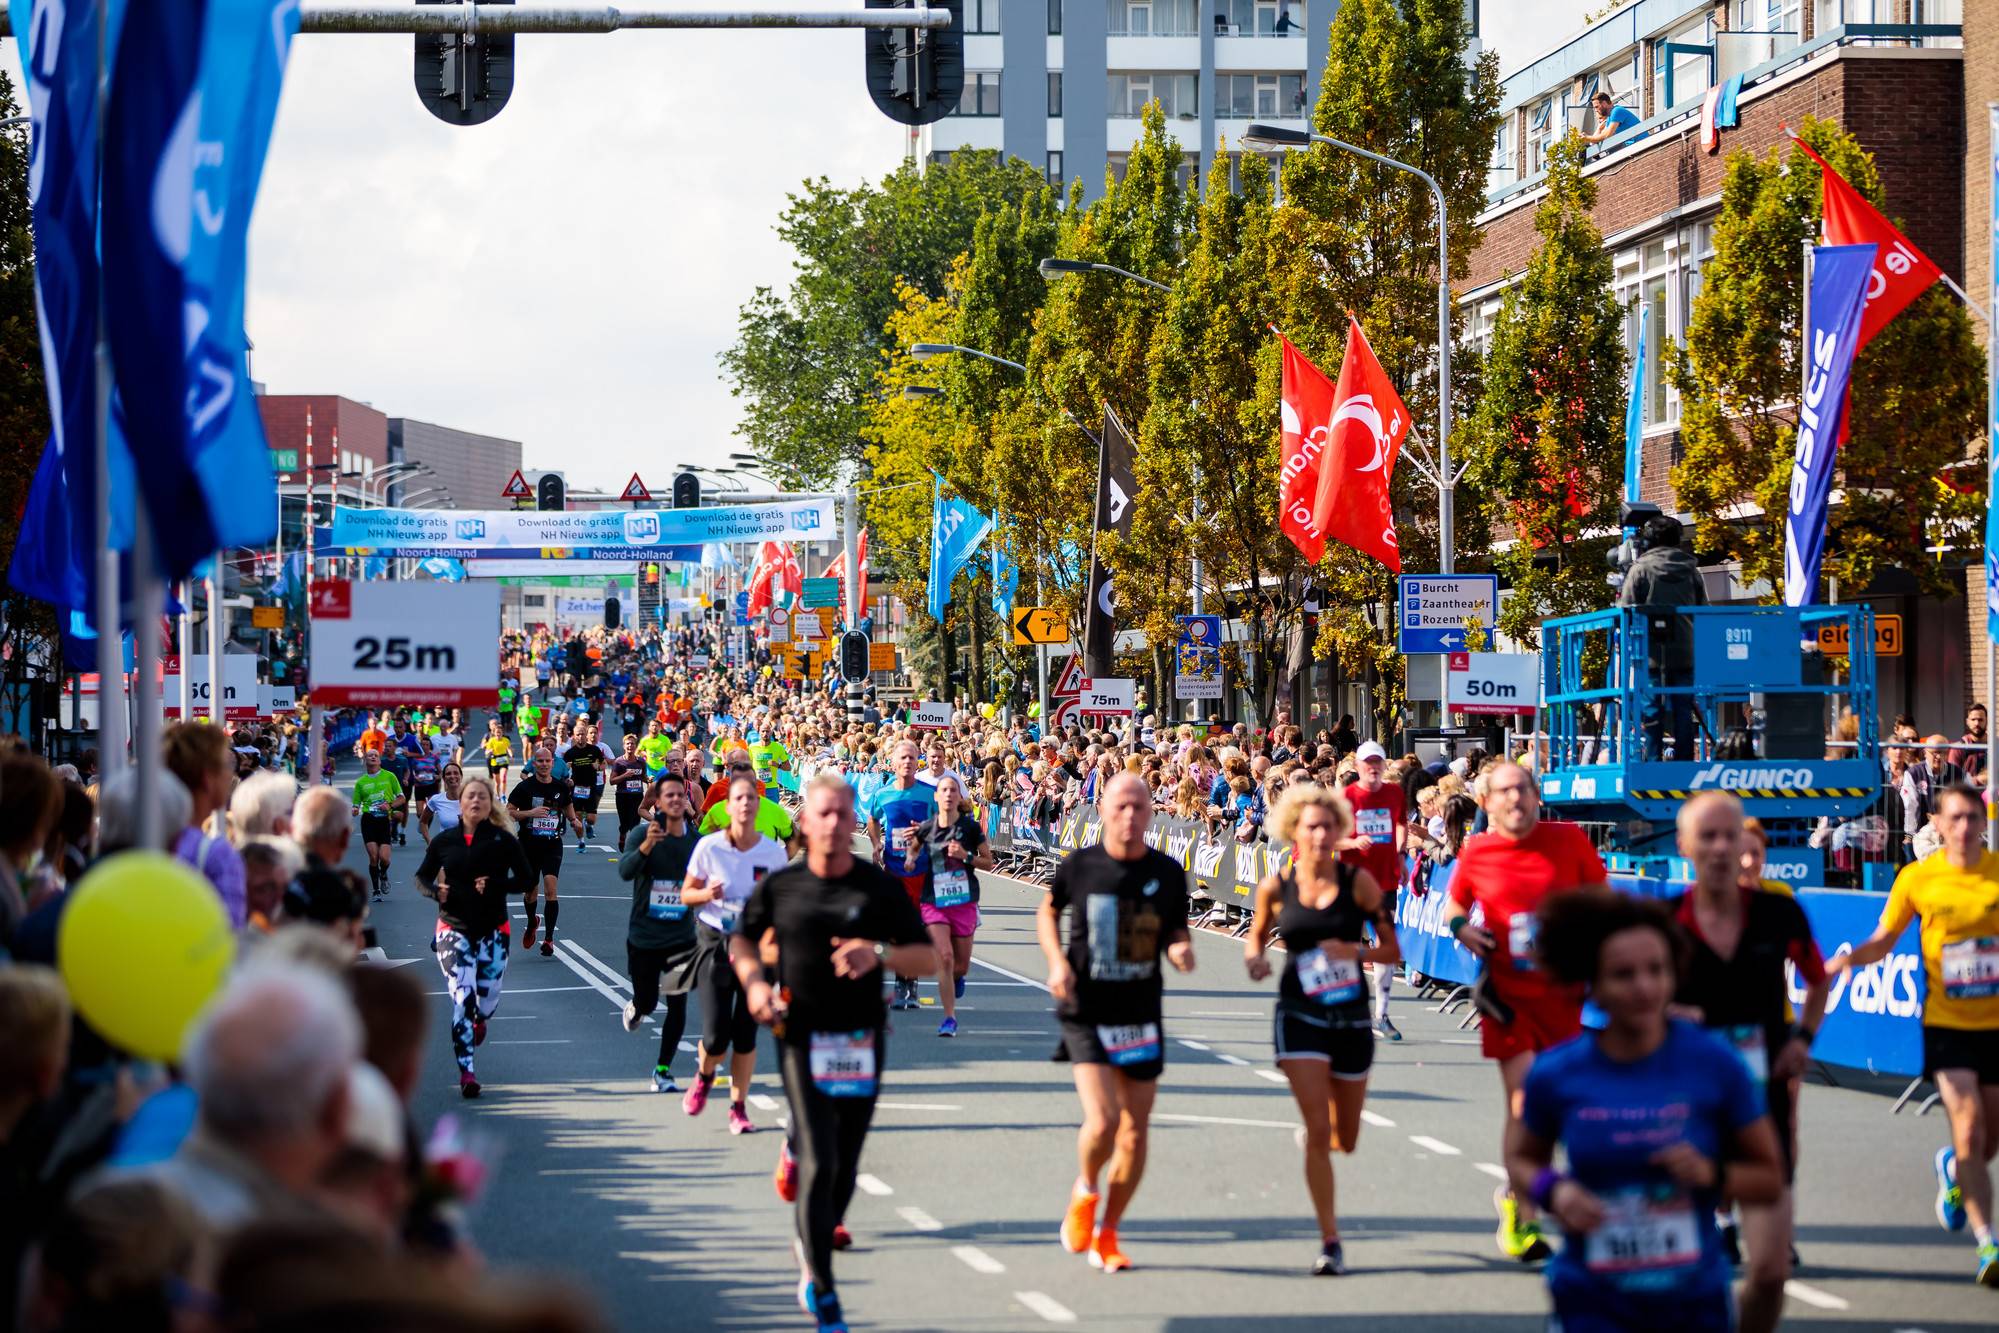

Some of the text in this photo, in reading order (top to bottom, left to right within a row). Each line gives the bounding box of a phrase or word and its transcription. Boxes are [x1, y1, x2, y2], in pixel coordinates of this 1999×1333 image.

[1789, 328, 1837, 515] asics
[345, 514, 448, 530] Download de gratis
[518, 516, 620, 530] Download de gratis
[685, 510, 784, 524] Download de gratis
[793, 509, 819, 529] NH
[457, 521, 482, 536] NH
[630, 518, 656, 537] NH
[708, 523, 785, 536] NH Nieuws app
[367, 529, 448, 543] NH Nieuws app
[541, 529, 620, 542] NH Nieuws app
[396, 548, 478, 559] Noord-Holland
[593, 549, 673, 560] Noord-Holland
[1422, 583, 1459, 593] Burcht
[1422, 615, 1476, 625] Rozenh
[352, 637, 457, 671] 25m
[1466, 679, 1516, 698] 50m
[1091, 695, 1120, 706] 75m
[916, 713, 945, 723] 100m
[1720, 767, 1813, 790] GUNCO
